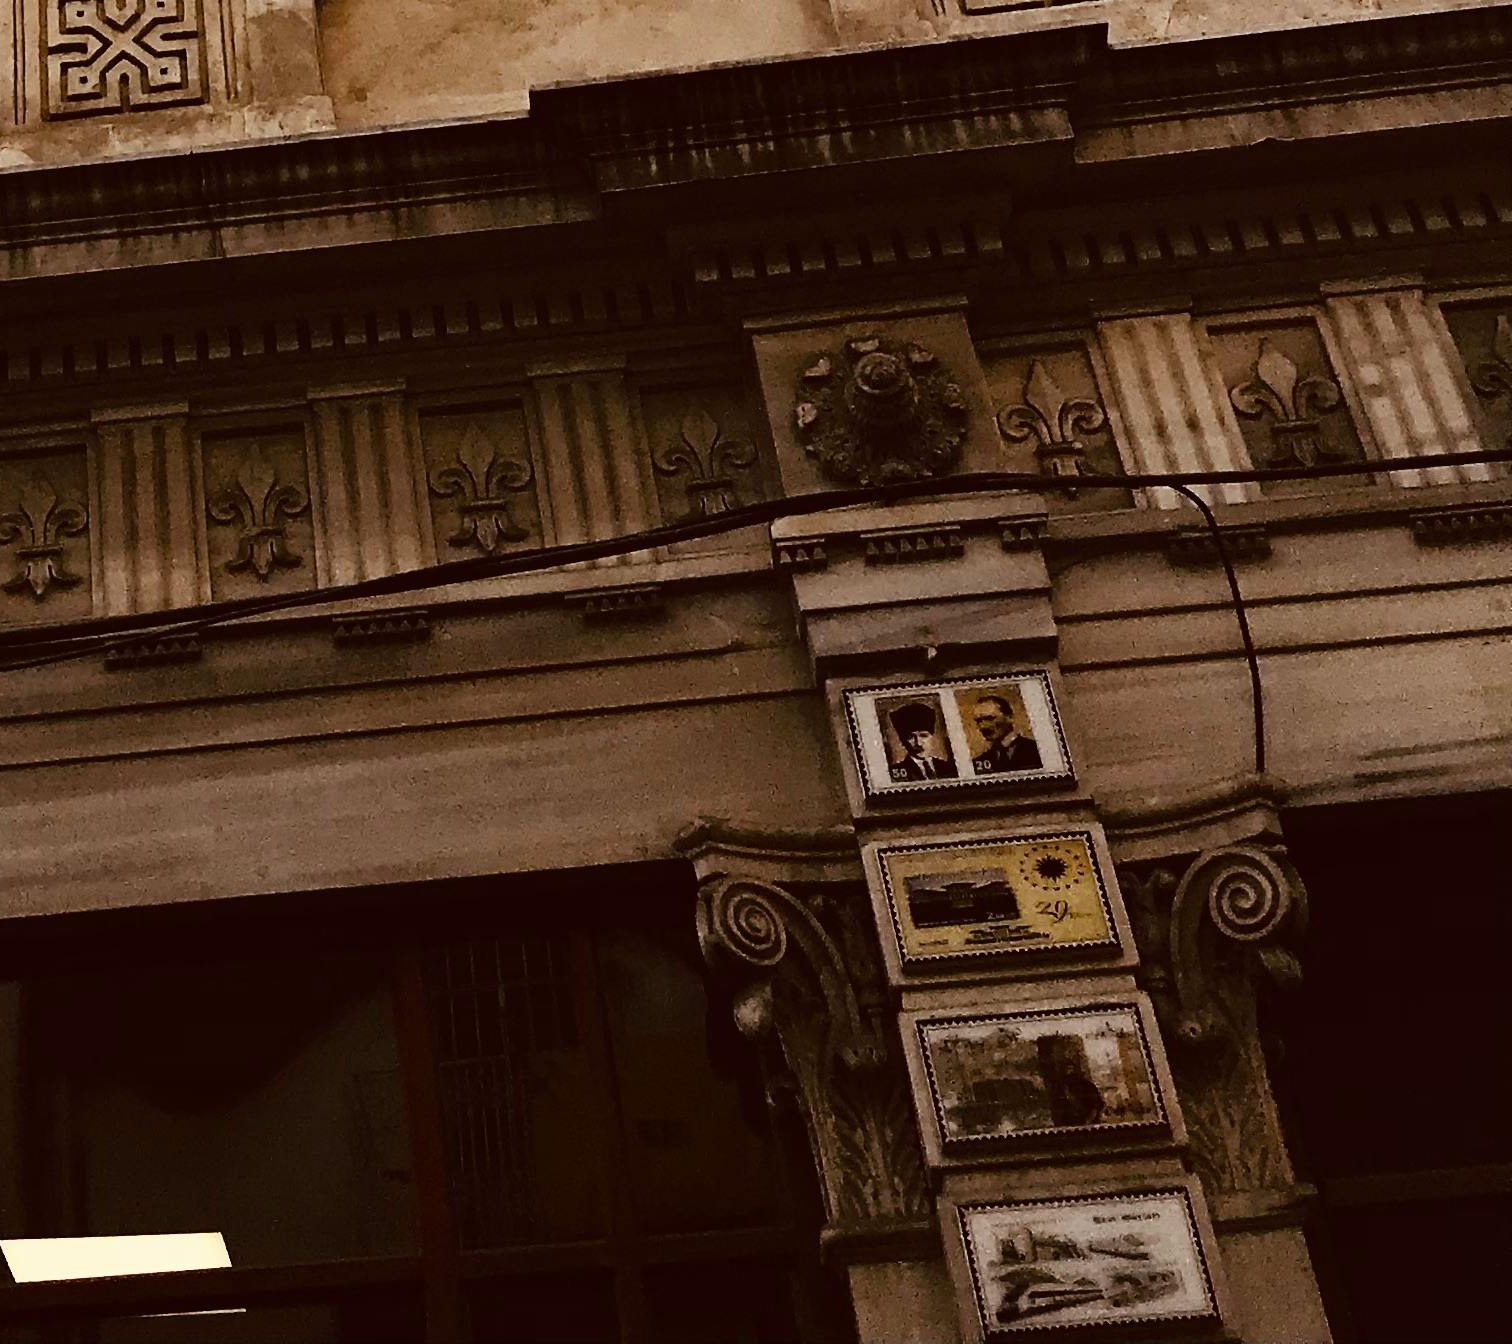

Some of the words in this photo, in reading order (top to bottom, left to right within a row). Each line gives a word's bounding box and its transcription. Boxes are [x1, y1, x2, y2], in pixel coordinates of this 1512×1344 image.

[975, 760, 992, 770] 20
[891, 768, 908, 778] 50
[1035, 899, 1069, 924] 29
